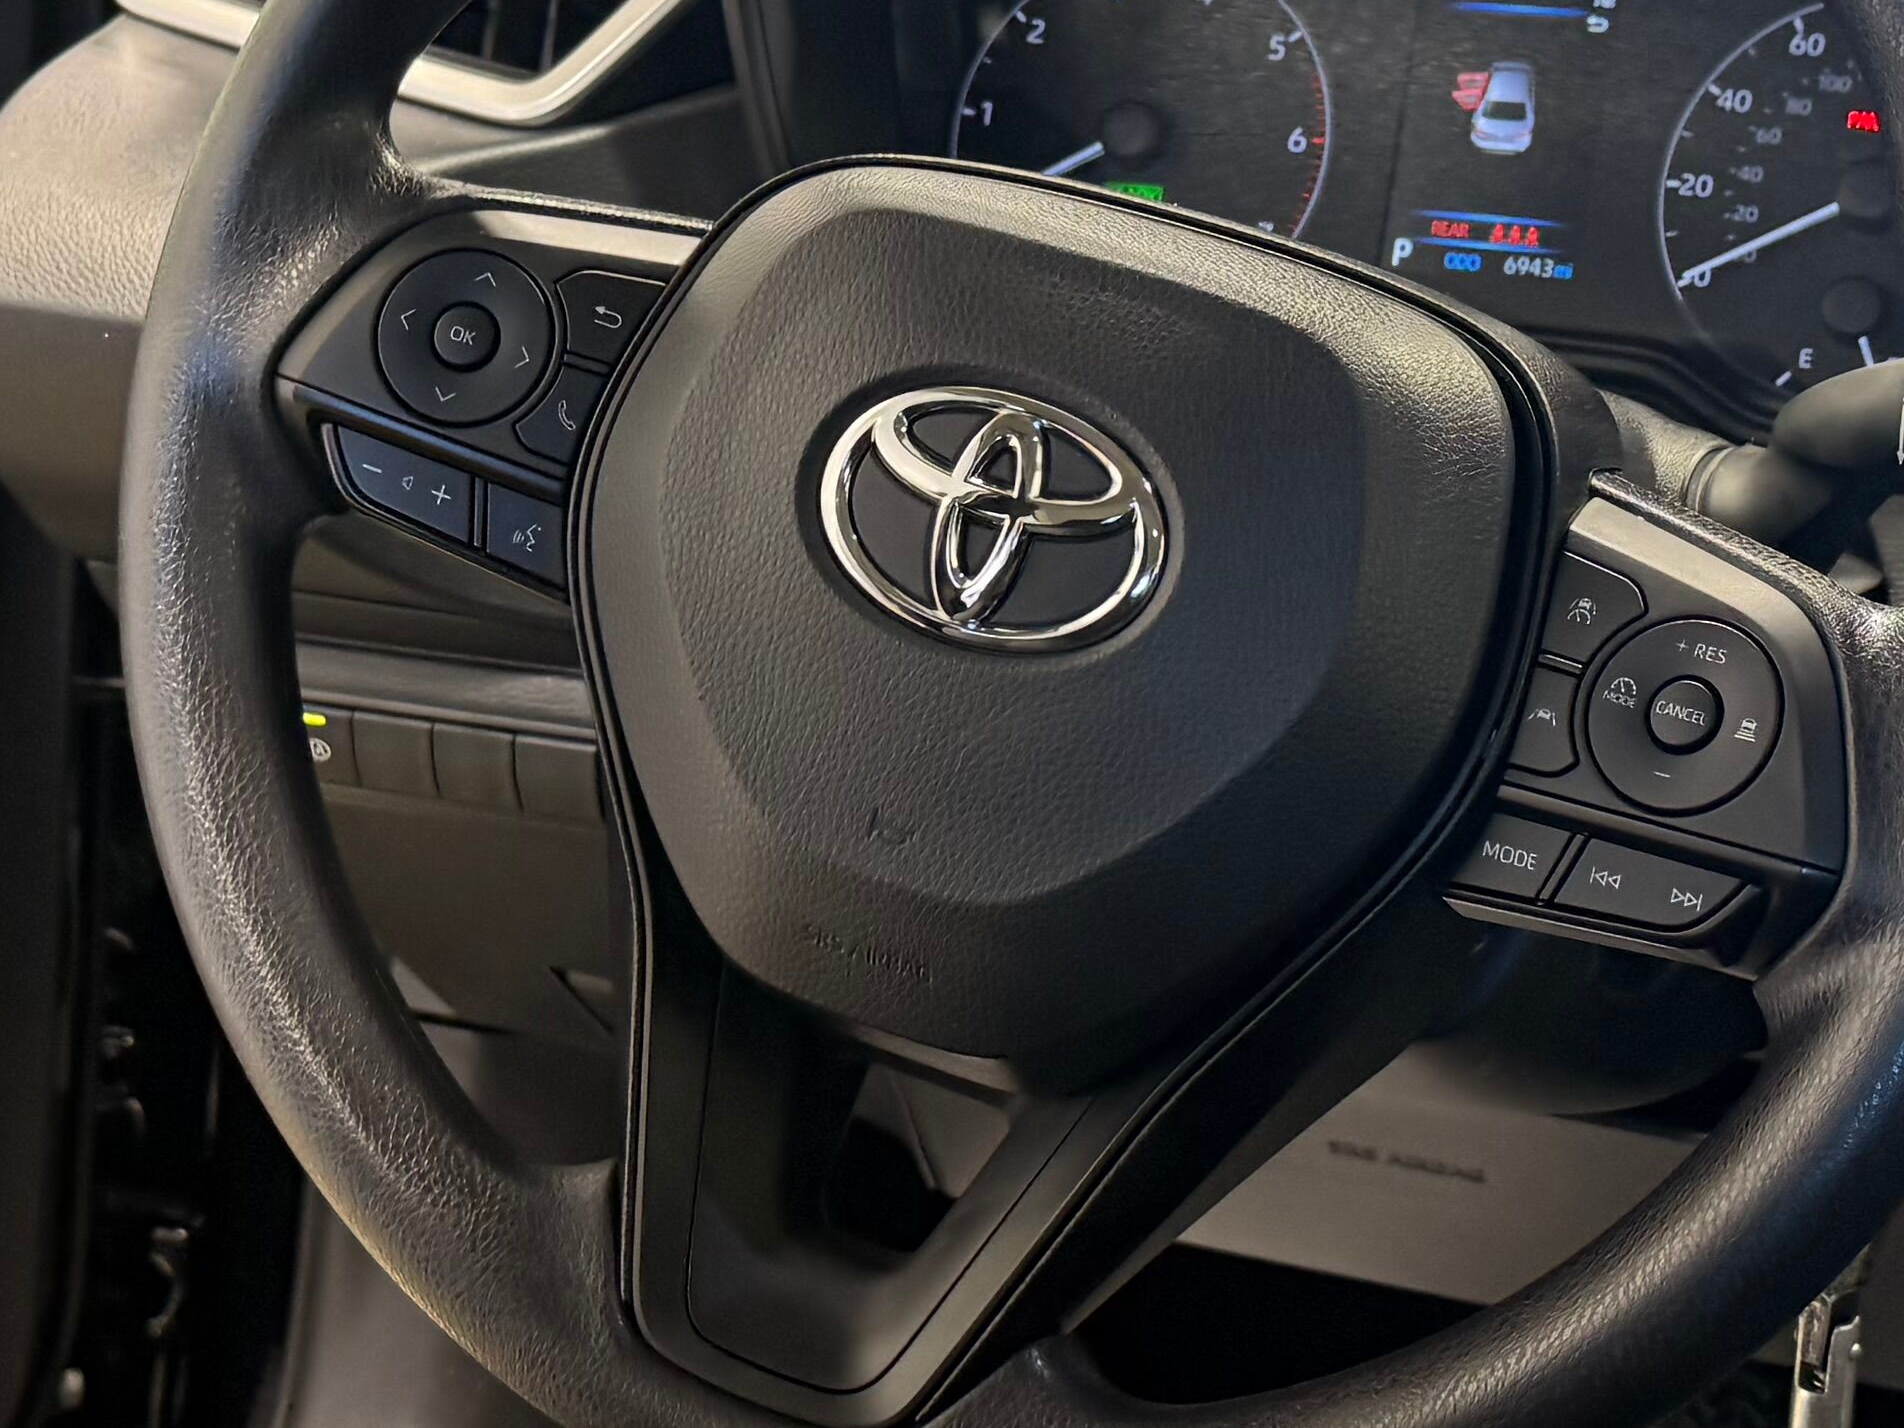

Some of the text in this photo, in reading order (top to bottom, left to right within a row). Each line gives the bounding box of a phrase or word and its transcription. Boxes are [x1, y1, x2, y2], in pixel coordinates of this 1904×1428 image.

[1026, 19, 1046, 44] 2
[1267, 35, 1286, 61] 5
[1789, 33, 1826, 57] 60
[1717, 89, 1753, 113] 40
[980, 102, 994, 126] 1
[1287, 127, 1307, 153] 6
[1678, 174, 1714, 198] 20
[1431, 220, 1471, 239] REAR
[1392, 237, 1414, 267] P
[449, 325, 477, 346] OK
[1798, 348, 1814, 369] E
[1693, 643, 1728, 665] RES
[1602, 690, 1637, 709] MODE
[1655, 699, 1706, 726] CANCEL
[1482, 840, 1538, 870] MODE
